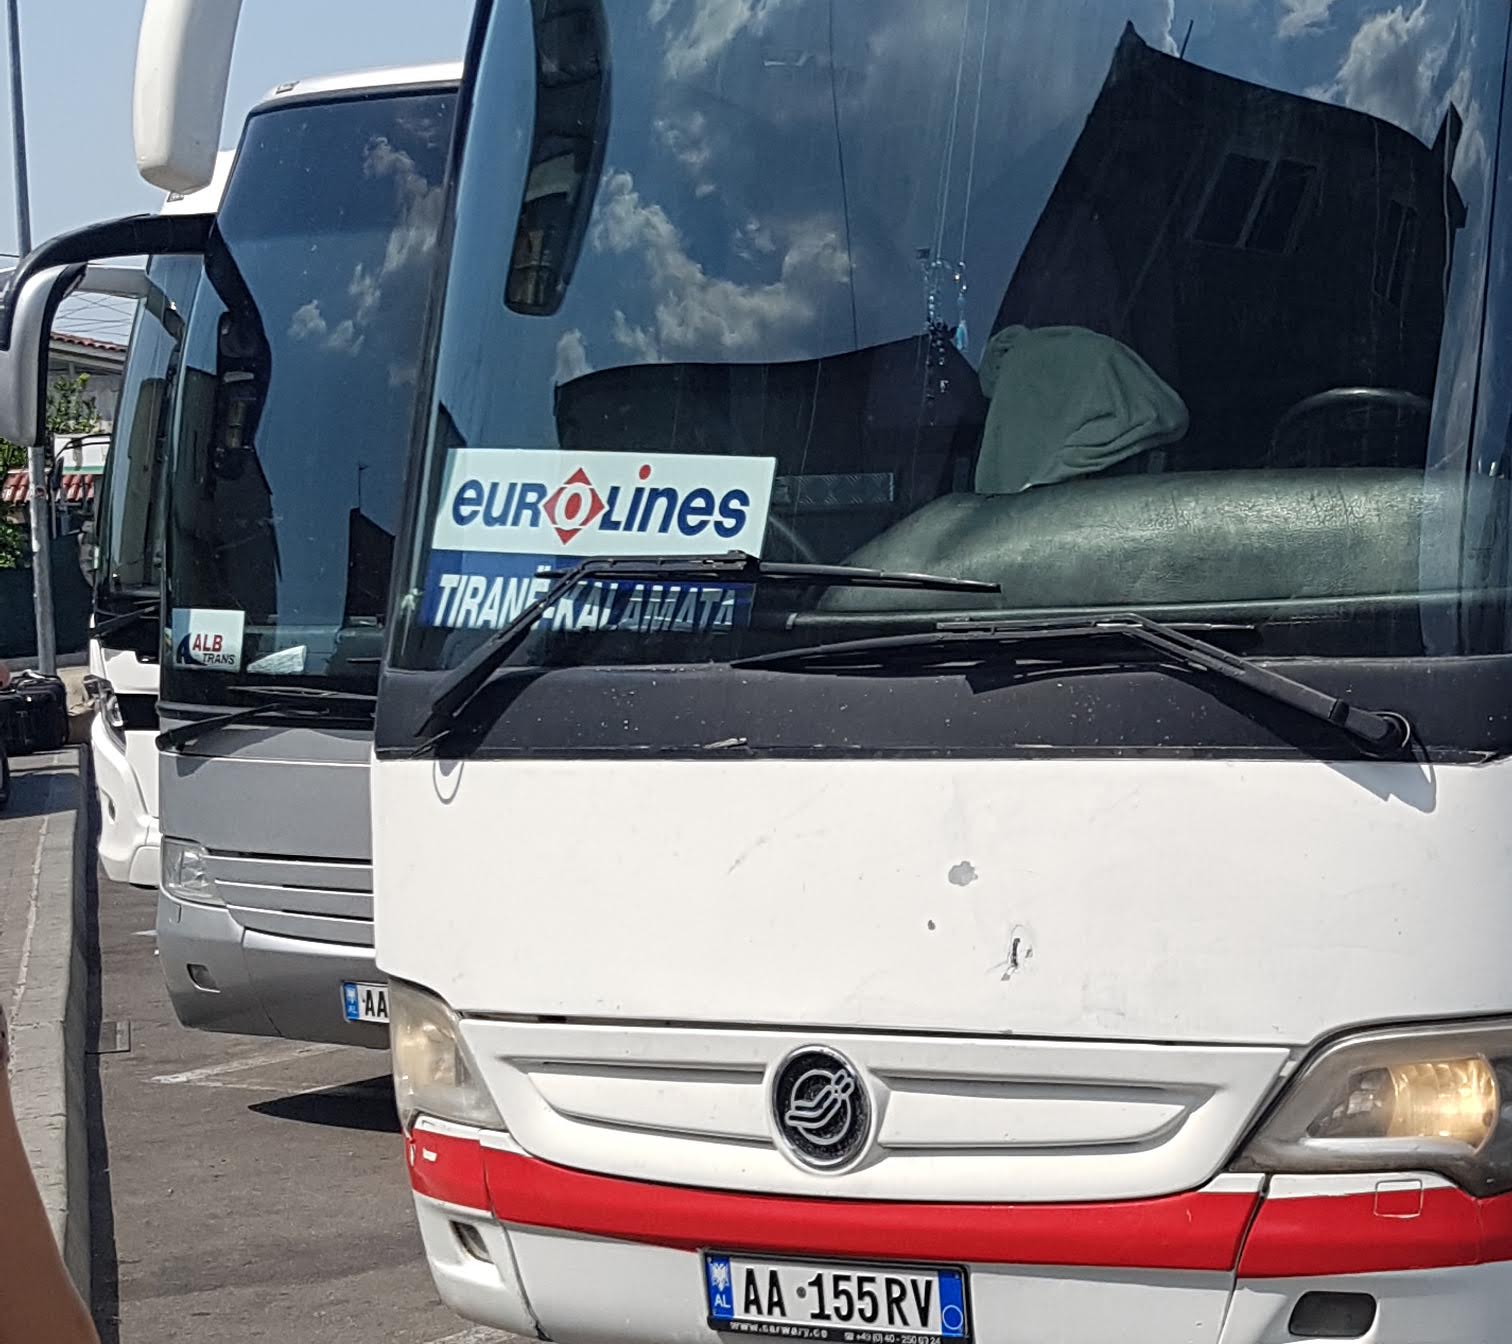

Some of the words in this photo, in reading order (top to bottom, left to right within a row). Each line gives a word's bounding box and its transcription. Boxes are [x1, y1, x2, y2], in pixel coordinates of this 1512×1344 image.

[192, 633, 223, 652] ALB
[202, 653, 236, 665] TRANS
[714, 1294, 731, 1308] AL
[743, 1267, 787, 1317] AA
[806, 1272, 933, 1328] 155RV
